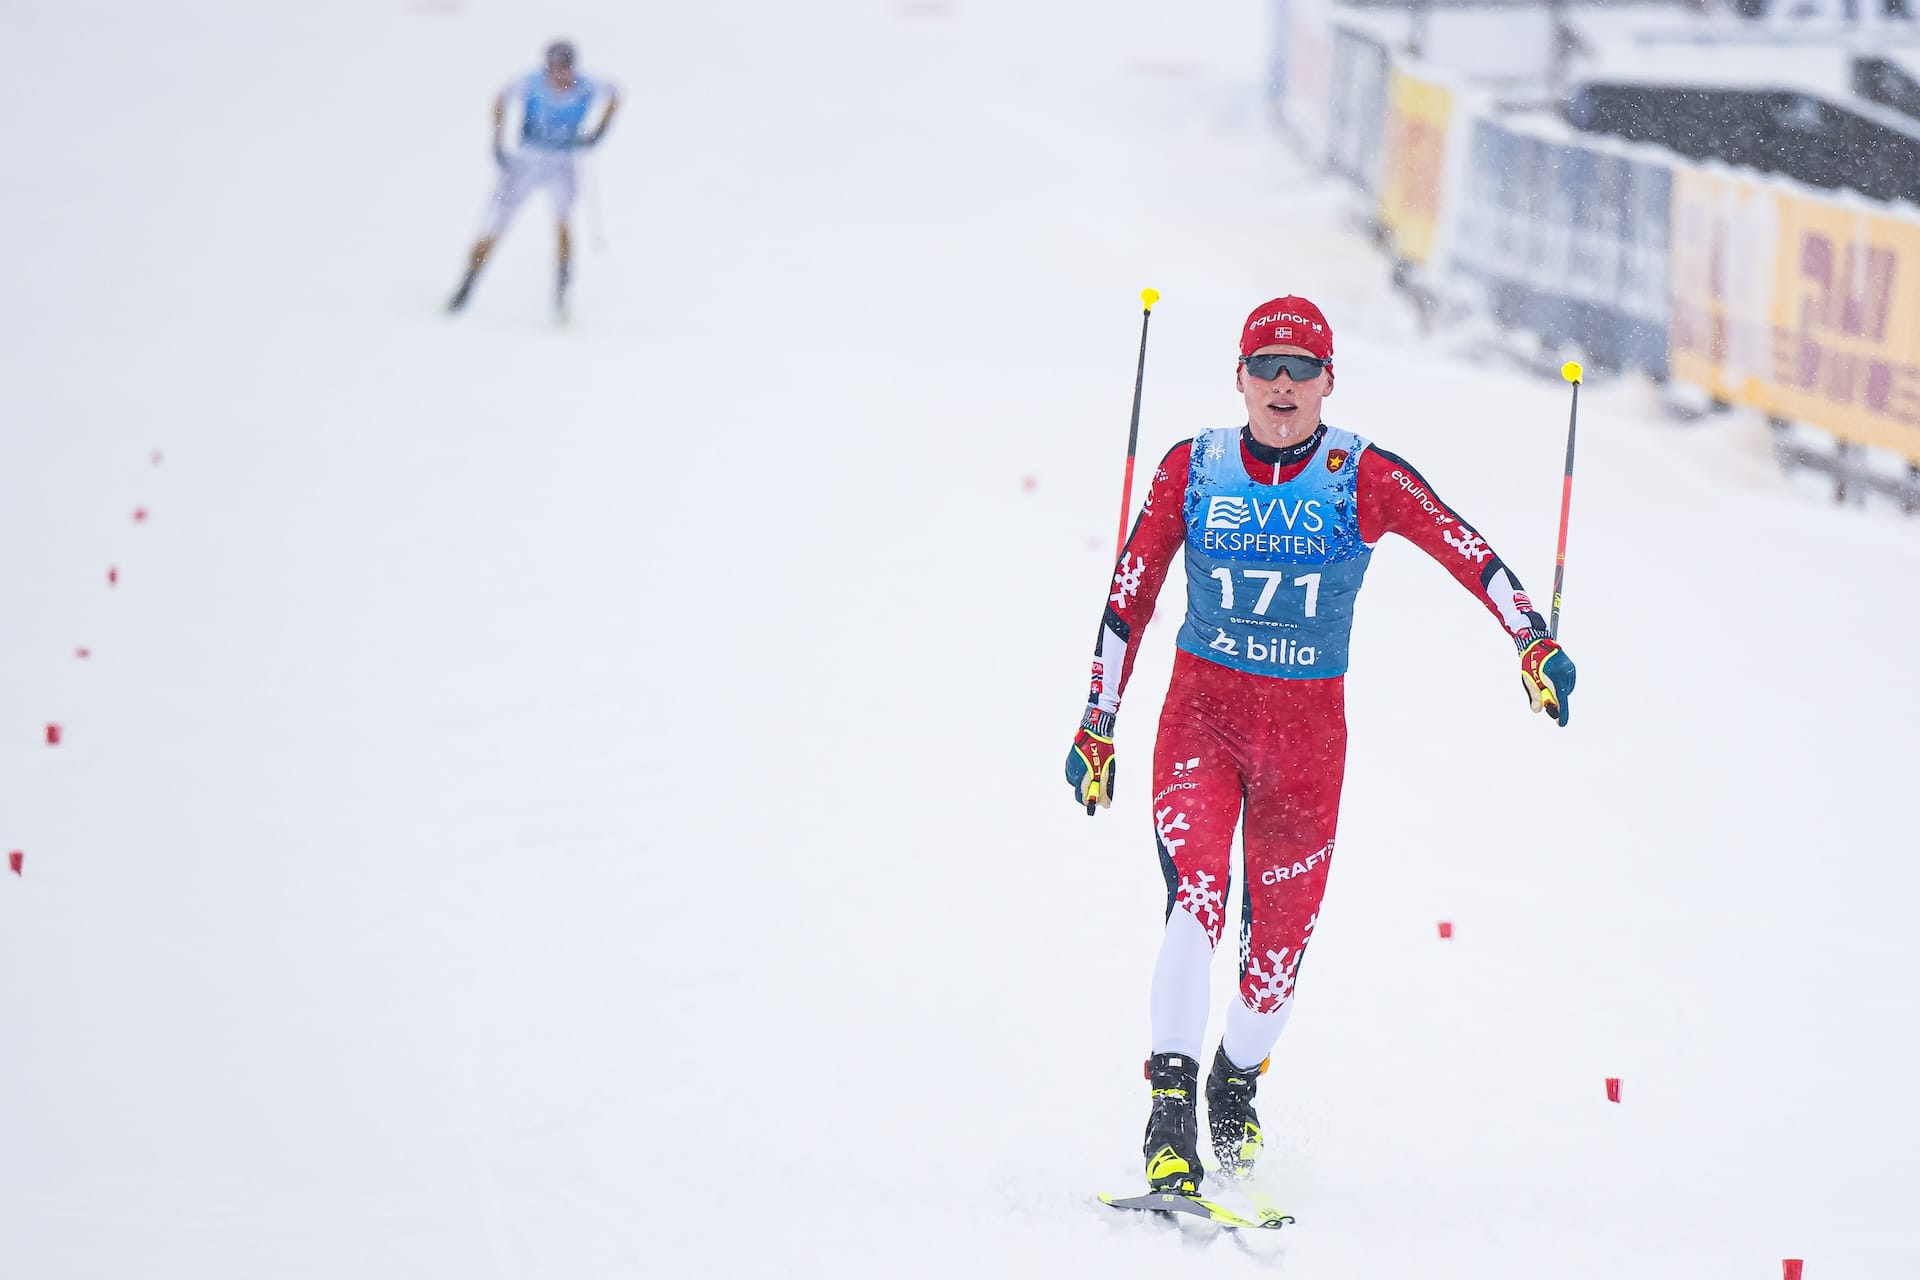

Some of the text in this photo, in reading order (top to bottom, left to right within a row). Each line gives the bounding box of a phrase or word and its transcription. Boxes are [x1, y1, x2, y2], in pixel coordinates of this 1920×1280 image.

[1249, 311, 1309, 331] equinor
[1391, 470, 1441, 515] equinor
[1252, 498, 1323, 533] VVS
[1203, 531, 1326, 556] EKSPERTEN
[1210, 567, 1322, 618] 171
[1247, 635, 1316, 666] bilia
[1261, 846, 1328, 886] CRAFT
